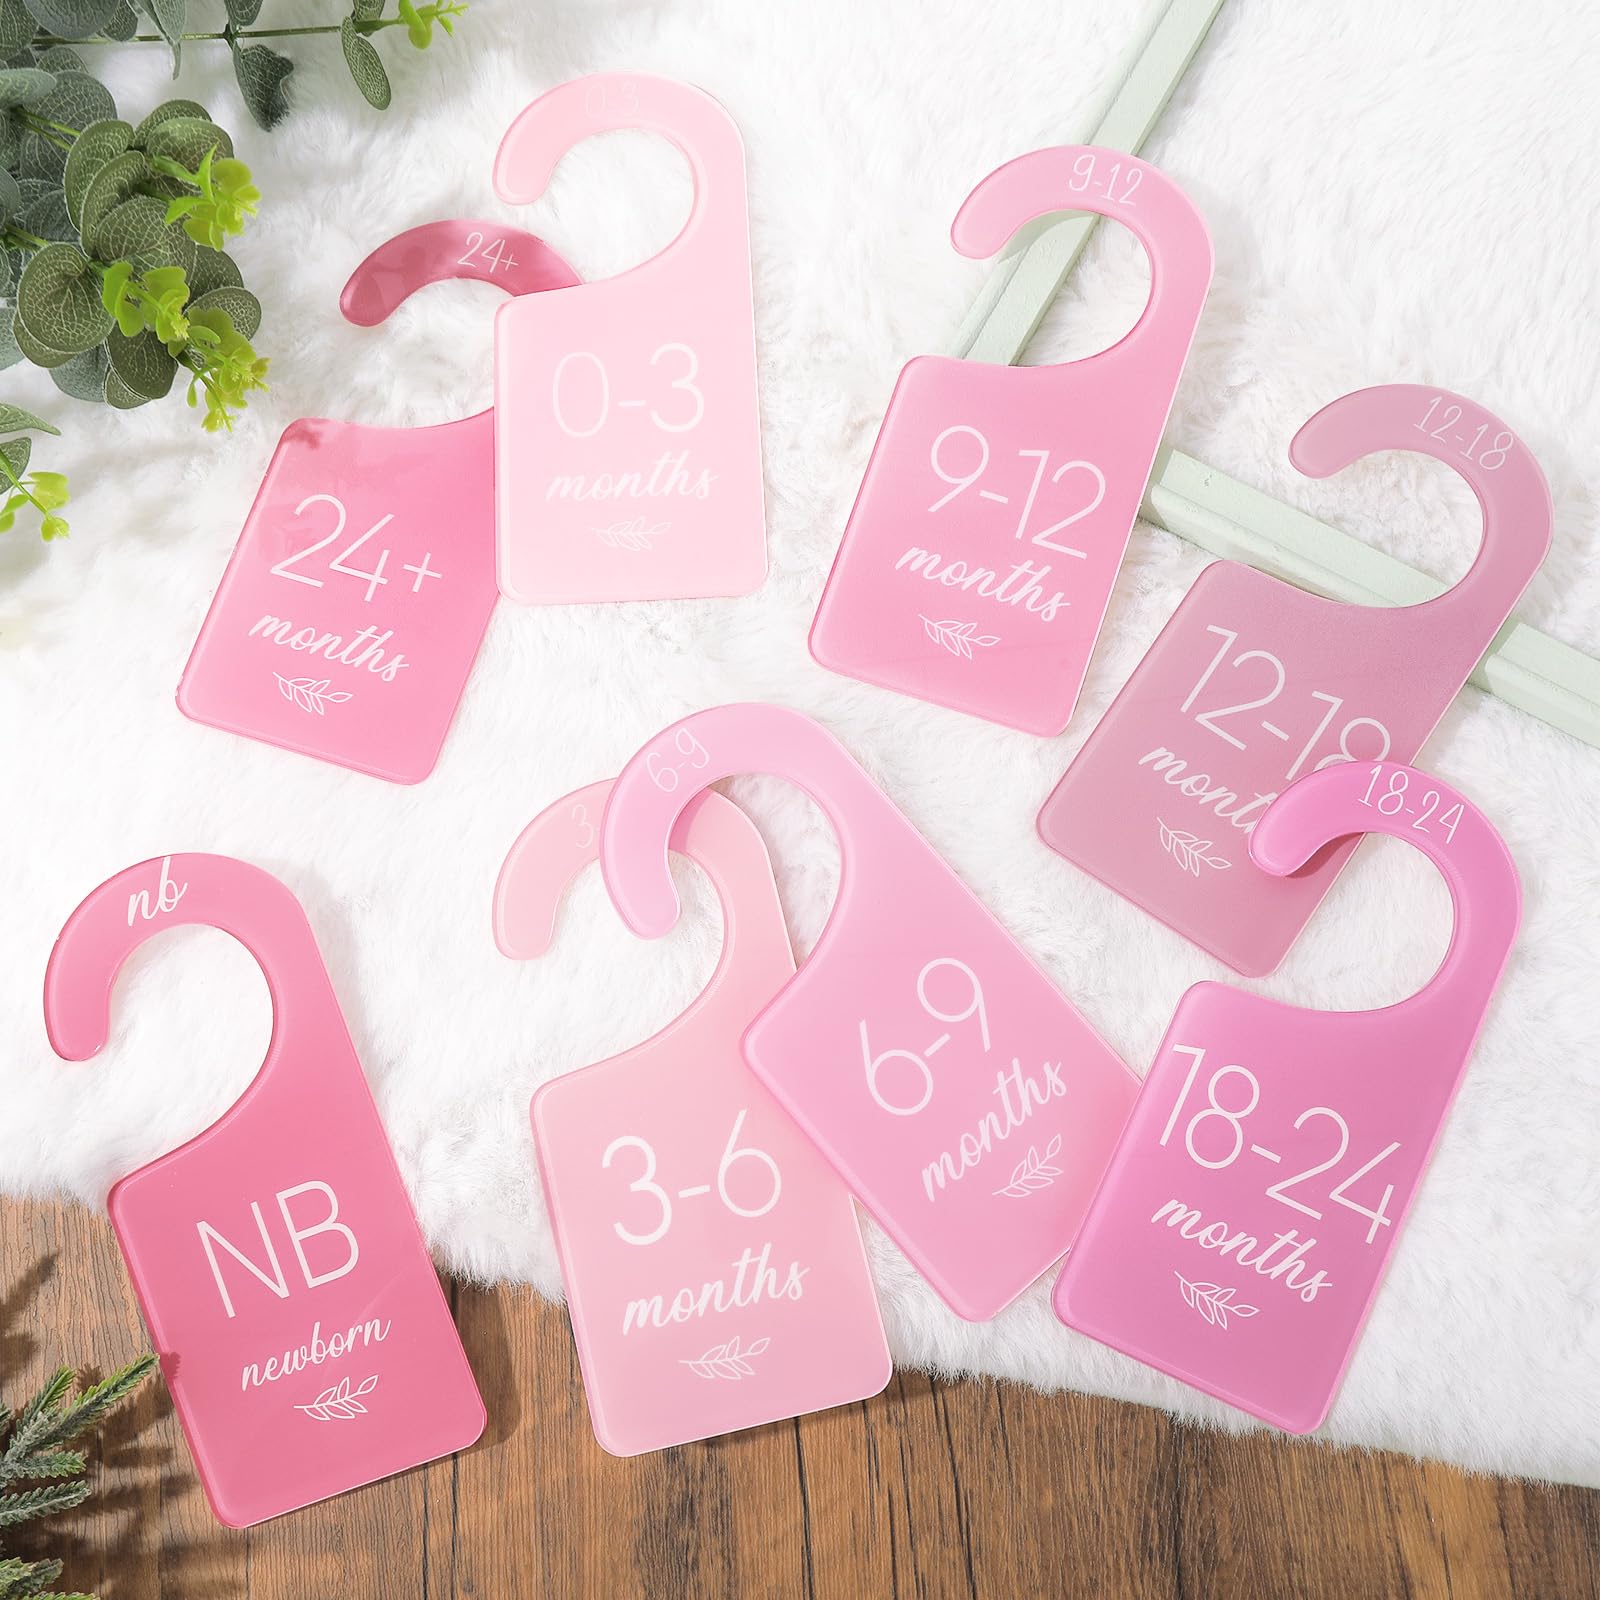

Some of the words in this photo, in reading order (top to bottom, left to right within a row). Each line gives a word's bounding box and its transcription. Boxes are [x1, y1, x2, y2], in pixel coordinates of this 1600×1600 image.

[1067, 154, 1144, 207] 9-12
[457, 231, 519, 276] 24+
[551, 342, 706, 439] 0-3
[1412, 395, 1516, 472] 12-18
[546, 451, 717, 505] months
[928, 425, 1107, 561] 9-12
[270, 493, 443, 604] 24+
[895, 542, 1071, 623] months
[249, 610, 410, 684] months
[646, 727, 710, 793] 6-9
[1138, 746, 1280, 834] mont
[1357, 764, 1465, 845] 18-24
[127, 855, 189, 927] nb
[858, 957, 992, 1117] 6-9
[920, 1057, 1069, 1203] months
[1158, 1043, 1402, 1245] 18-24
[601, 1110, 783, 1247] 3-6
[195, 1180, 361, 1320] NB
[621, 1246, 811, 1337] months
[1150, 1194, 1333, 1304] months
[240, 1316, 391, 1392] newborn
